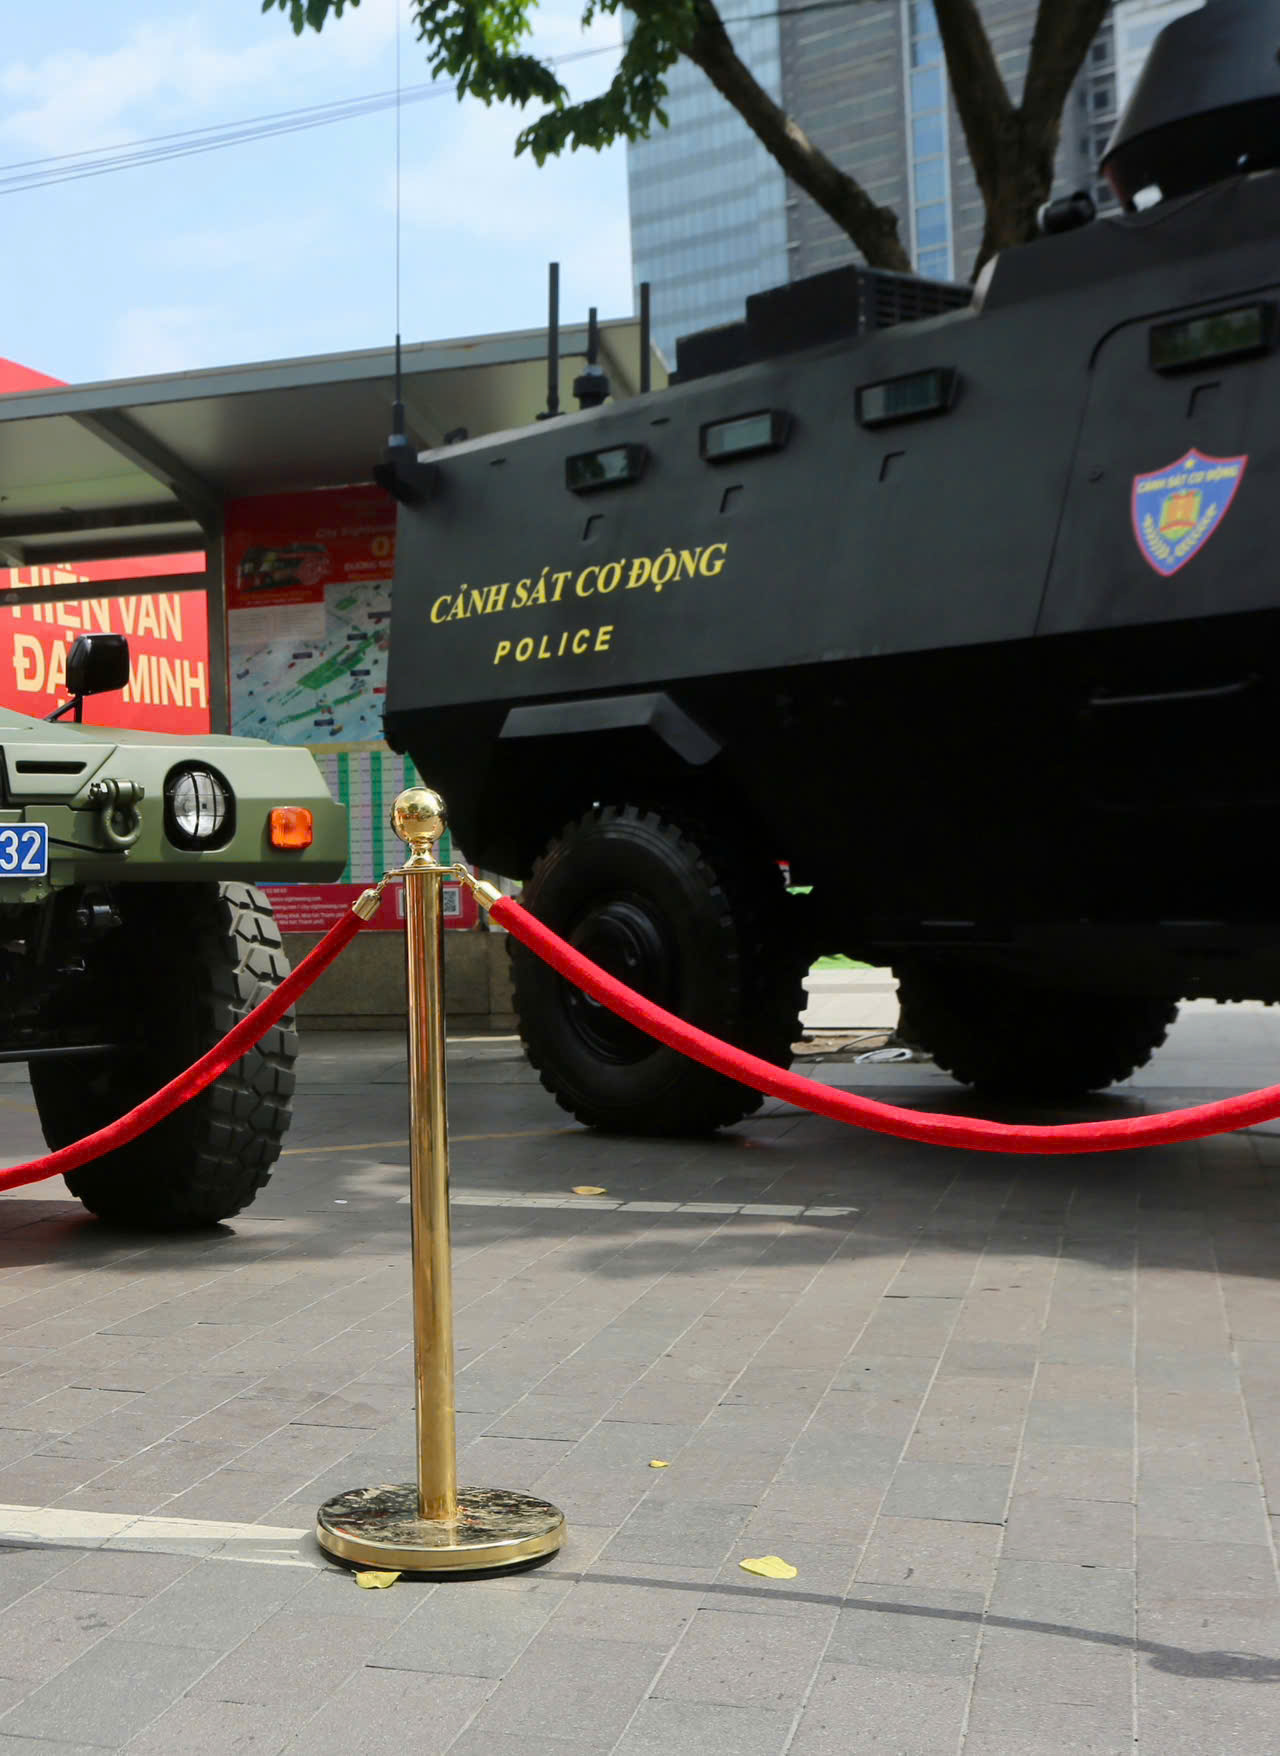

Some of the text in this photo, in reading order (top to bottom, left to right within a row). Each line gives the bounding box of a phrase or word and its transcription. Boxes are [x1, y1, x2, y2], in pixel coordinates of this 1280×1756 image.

[430, 543, 728, 623] CẢNH SÁT CƠ ĐỘNG
[13, 633, 208, 709] ĐẠ MINH
[493, 625, 614, 665] POLICE
